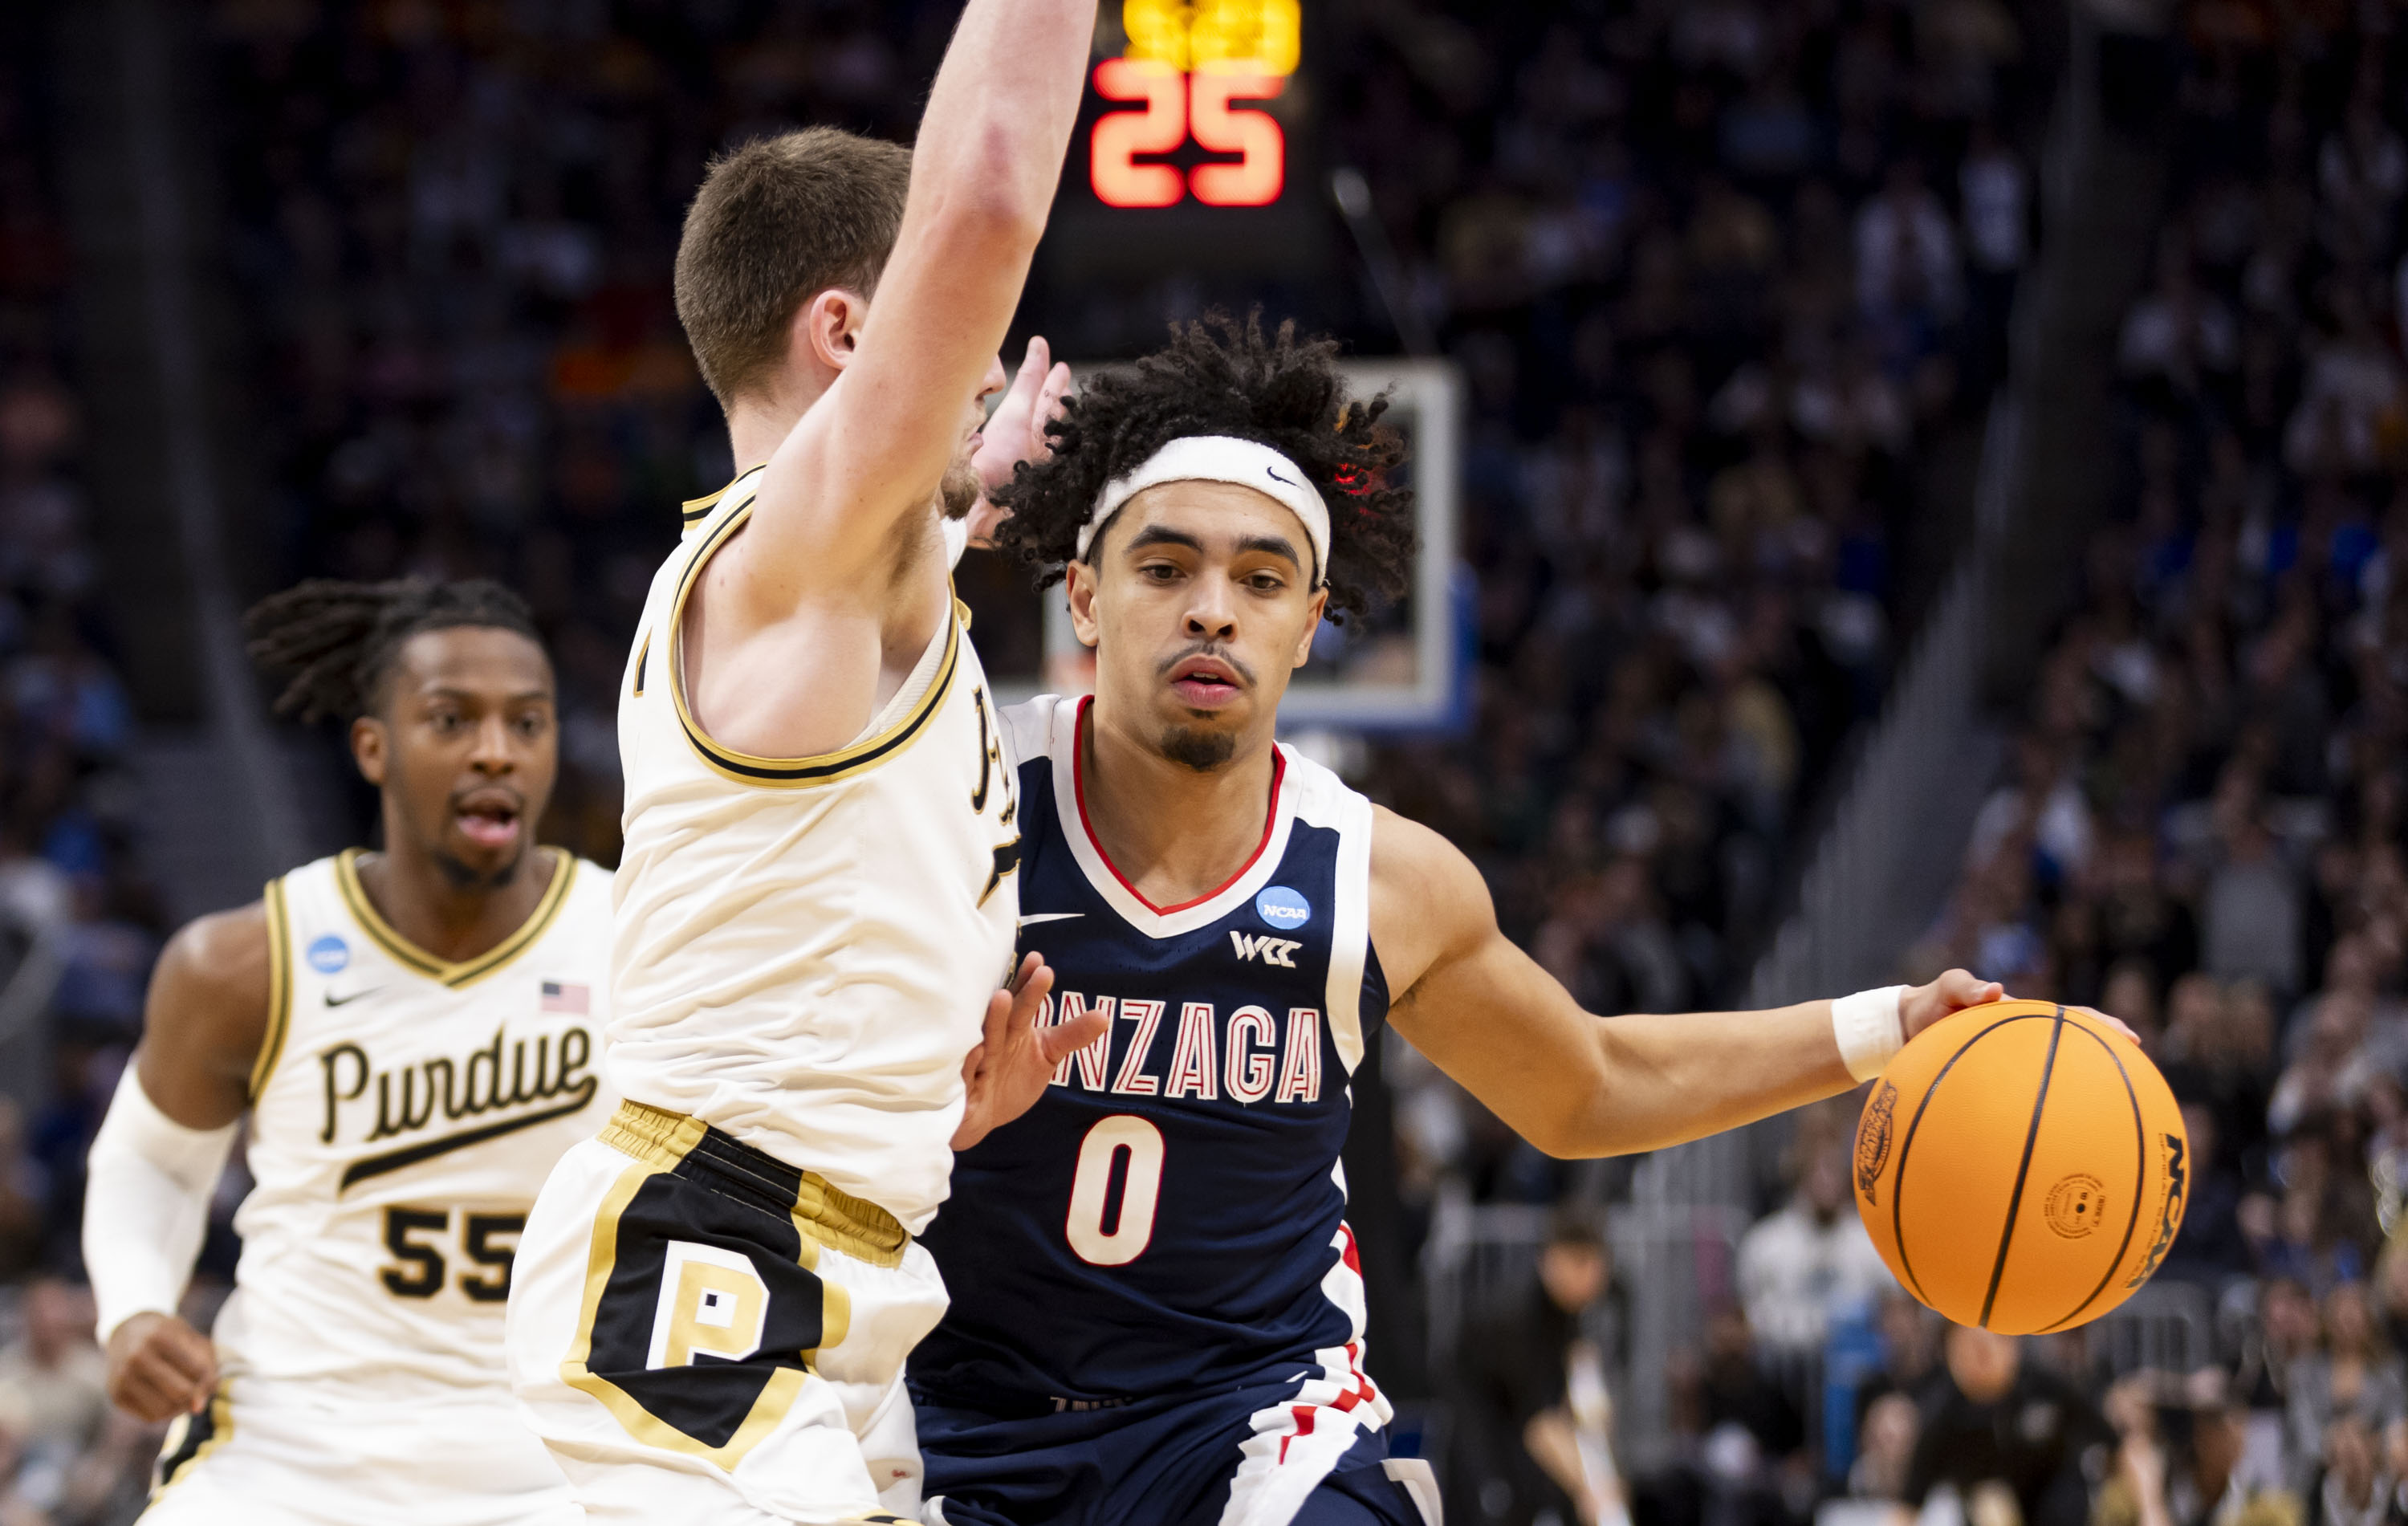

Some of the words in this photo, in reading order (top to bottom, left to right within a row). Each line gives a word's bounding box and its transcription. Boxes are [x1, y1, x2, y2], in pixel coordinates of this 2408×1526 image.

[1090, 57, 1285, 209] 25
[1229, 930, 1304, 969] WCC
[1263, 904, 1307, 920] NCAA
[319, 1019, 595, 1144] Purdue
[1064, 1113, 1166, 1268] 0
[376, 1206, 527, 1304] 55
[646, 1239, 771, 1371] P
